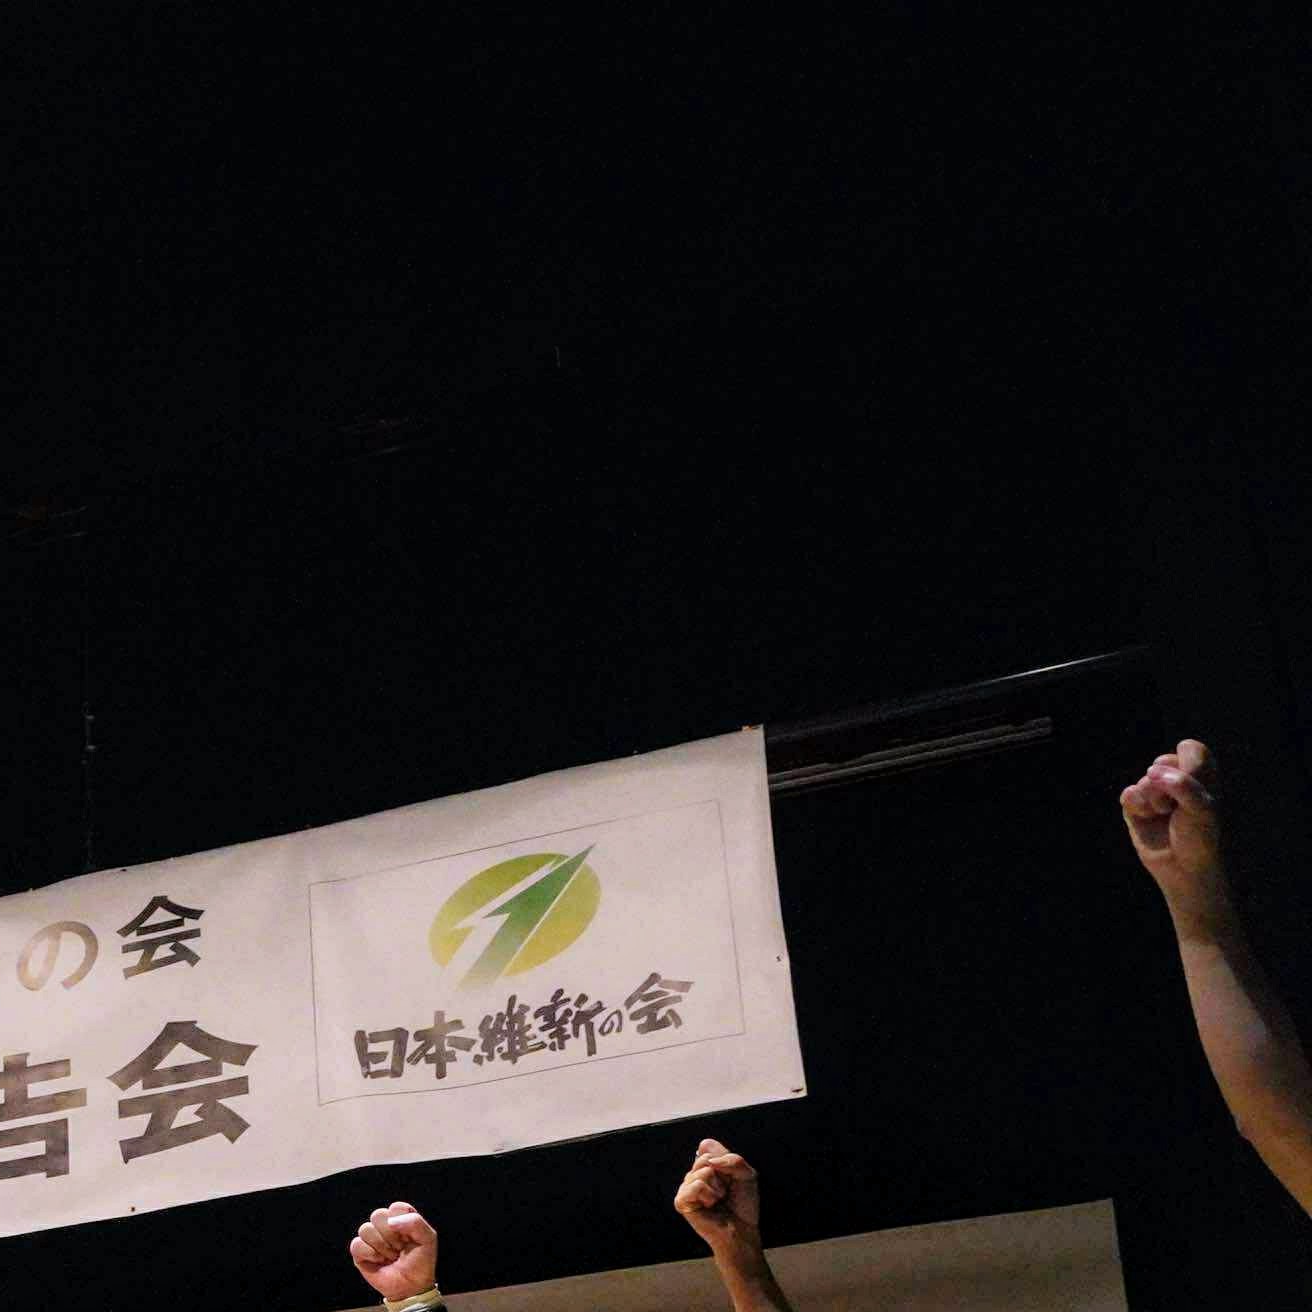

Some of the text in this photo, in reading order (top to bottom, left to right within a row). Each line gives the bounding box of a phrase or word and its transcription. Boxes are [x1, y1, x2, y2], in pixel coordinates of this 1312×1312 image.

[353, 972, 696, 1080] 日本維新の会
